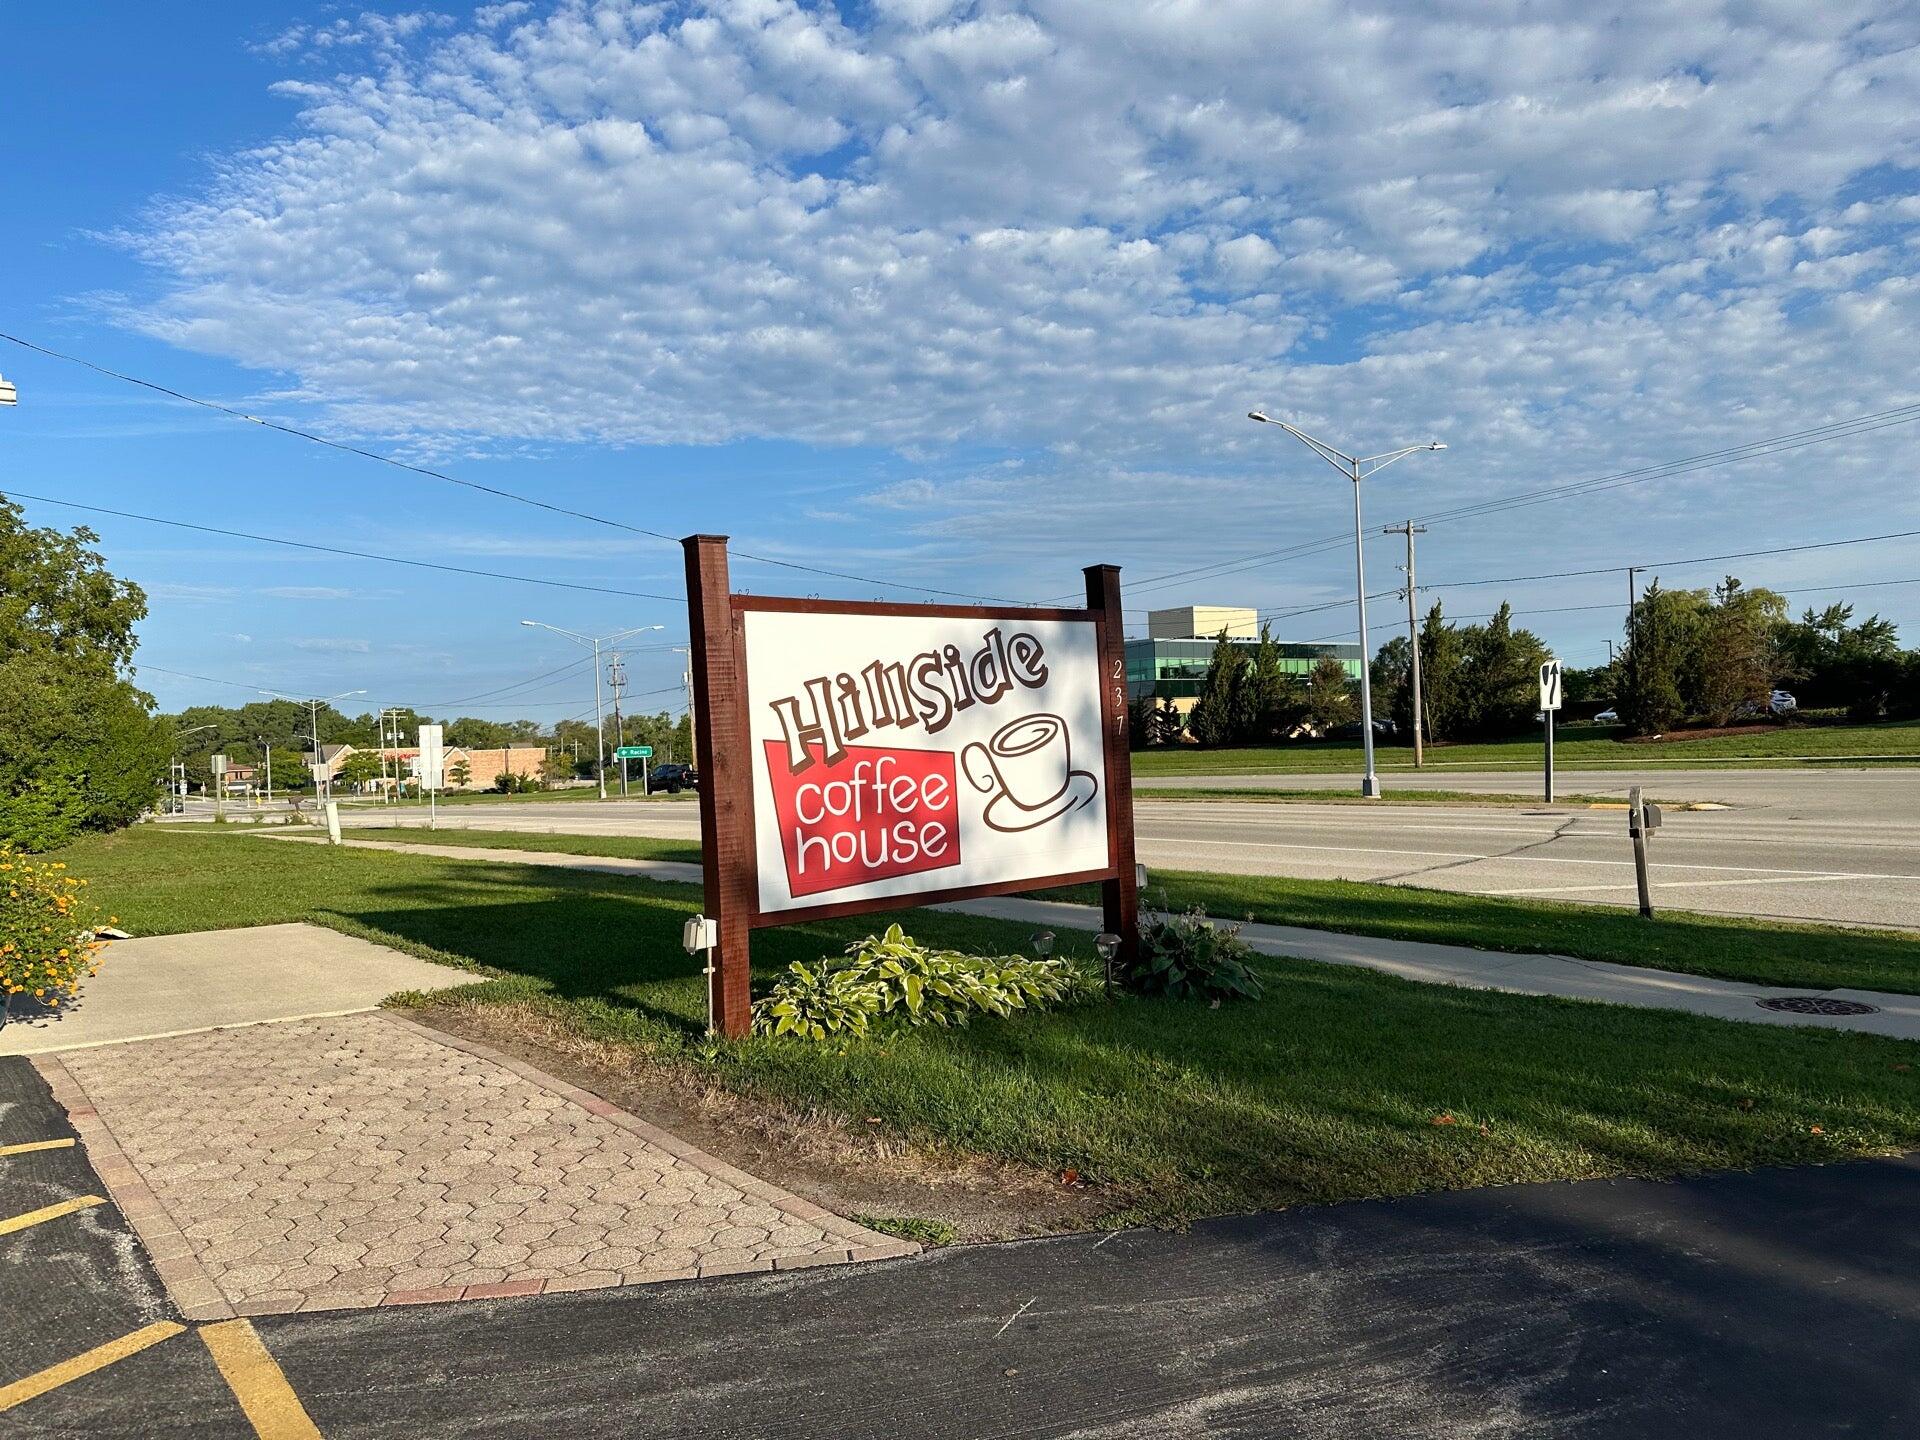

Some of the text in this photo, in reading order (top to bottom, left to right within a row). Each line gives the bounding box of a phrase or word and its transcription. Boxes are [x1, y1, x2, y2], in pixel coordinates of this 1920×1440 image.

[1113, 659, 1124, 736] 237
[795, 756, 950, 825] coffee
[796, 820, 948, 875] house
